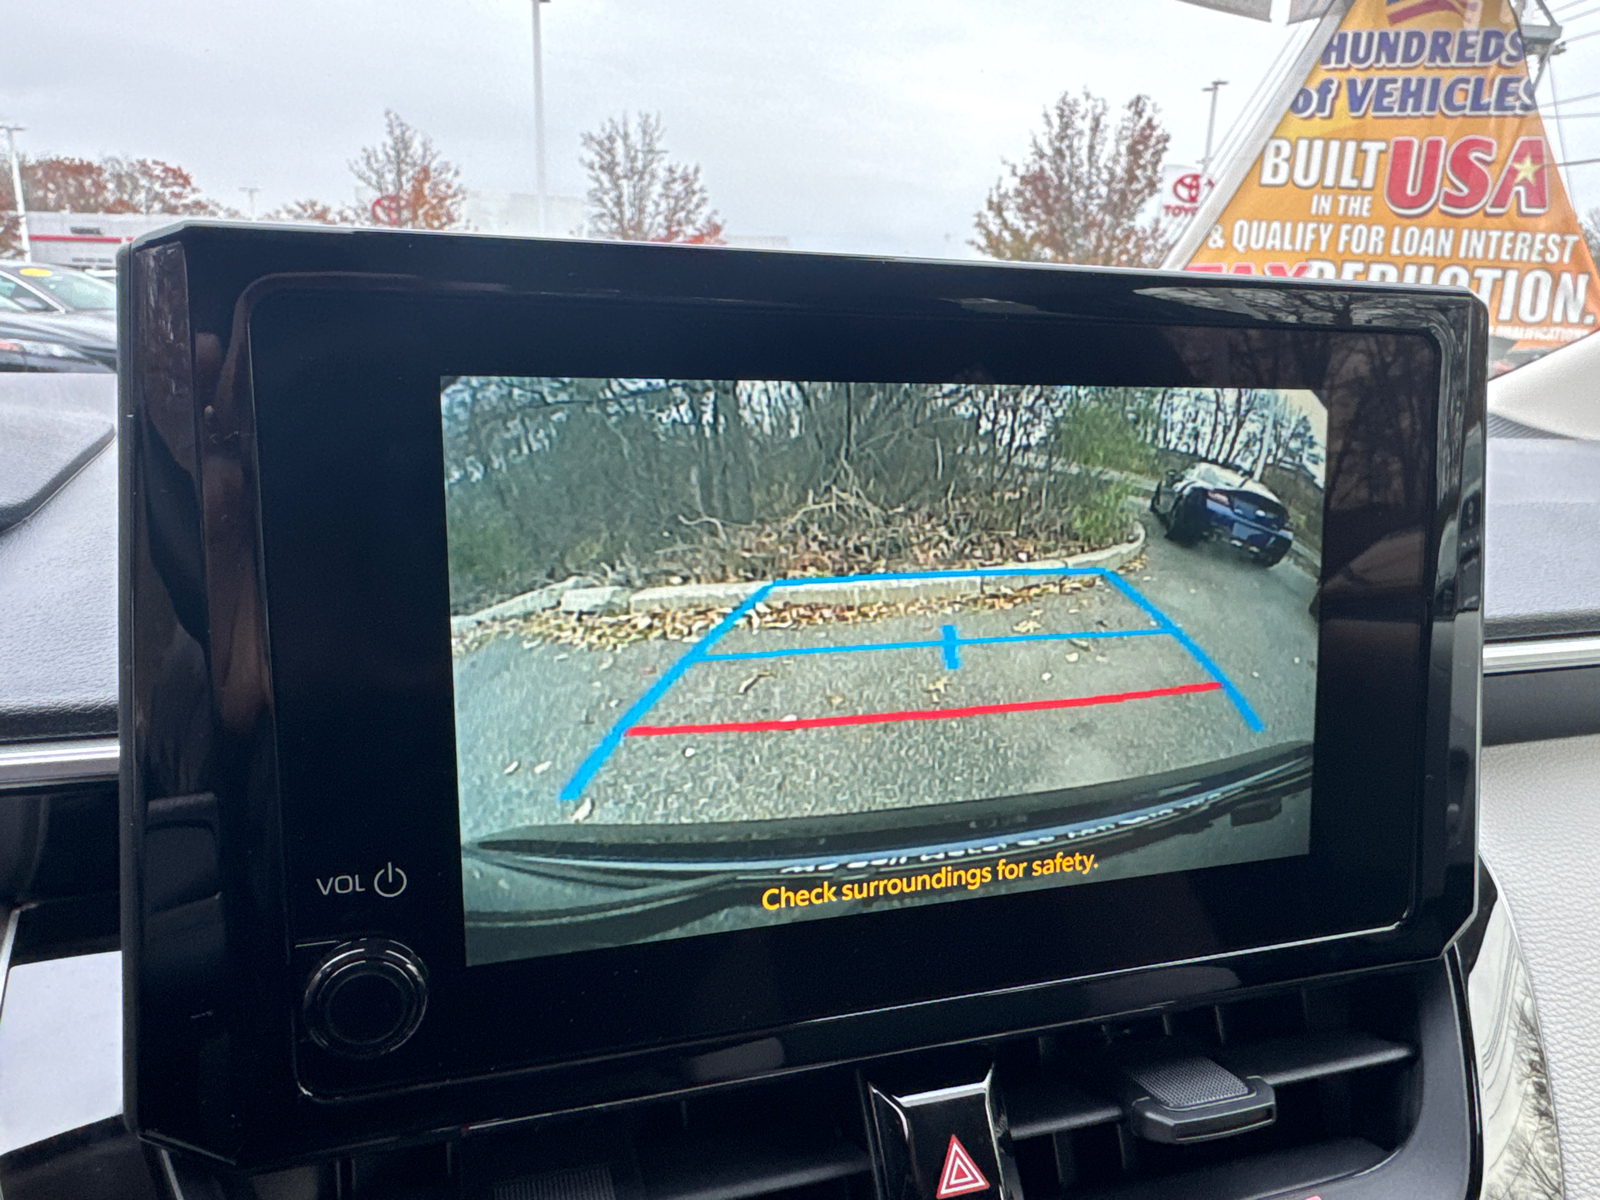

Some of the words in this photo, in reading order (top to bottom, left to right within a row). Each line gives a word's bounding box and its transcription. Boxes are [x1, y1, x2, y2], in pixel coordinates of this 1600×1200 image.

[1320, 29, 1526, 69] HUNDREDS
[1289, 77, 1339, 117] of
[1259, 138, 1387, 189] BUILT
[1384, 136, 1549, 217] USA
[1310, 194, 1333, 216] IN
[1337, 194, 1373, 217] THE
[1207, 224, 1226, 249] &
[1231, 218, 1334, 253] QUALIFY
[1337, 223, 1386, 255] FOR
[1389, 225, 1454, 259] LOAN
[1458, 228, 1580, 264] INTEREST
[316, 874, 366, 896] VOL
[762, 881, 837, 911] Check
[841, 866, 992, 901] surroundings
[996, 859, 1027, 881] for
[1031, 851, 1100, 880] safety.
